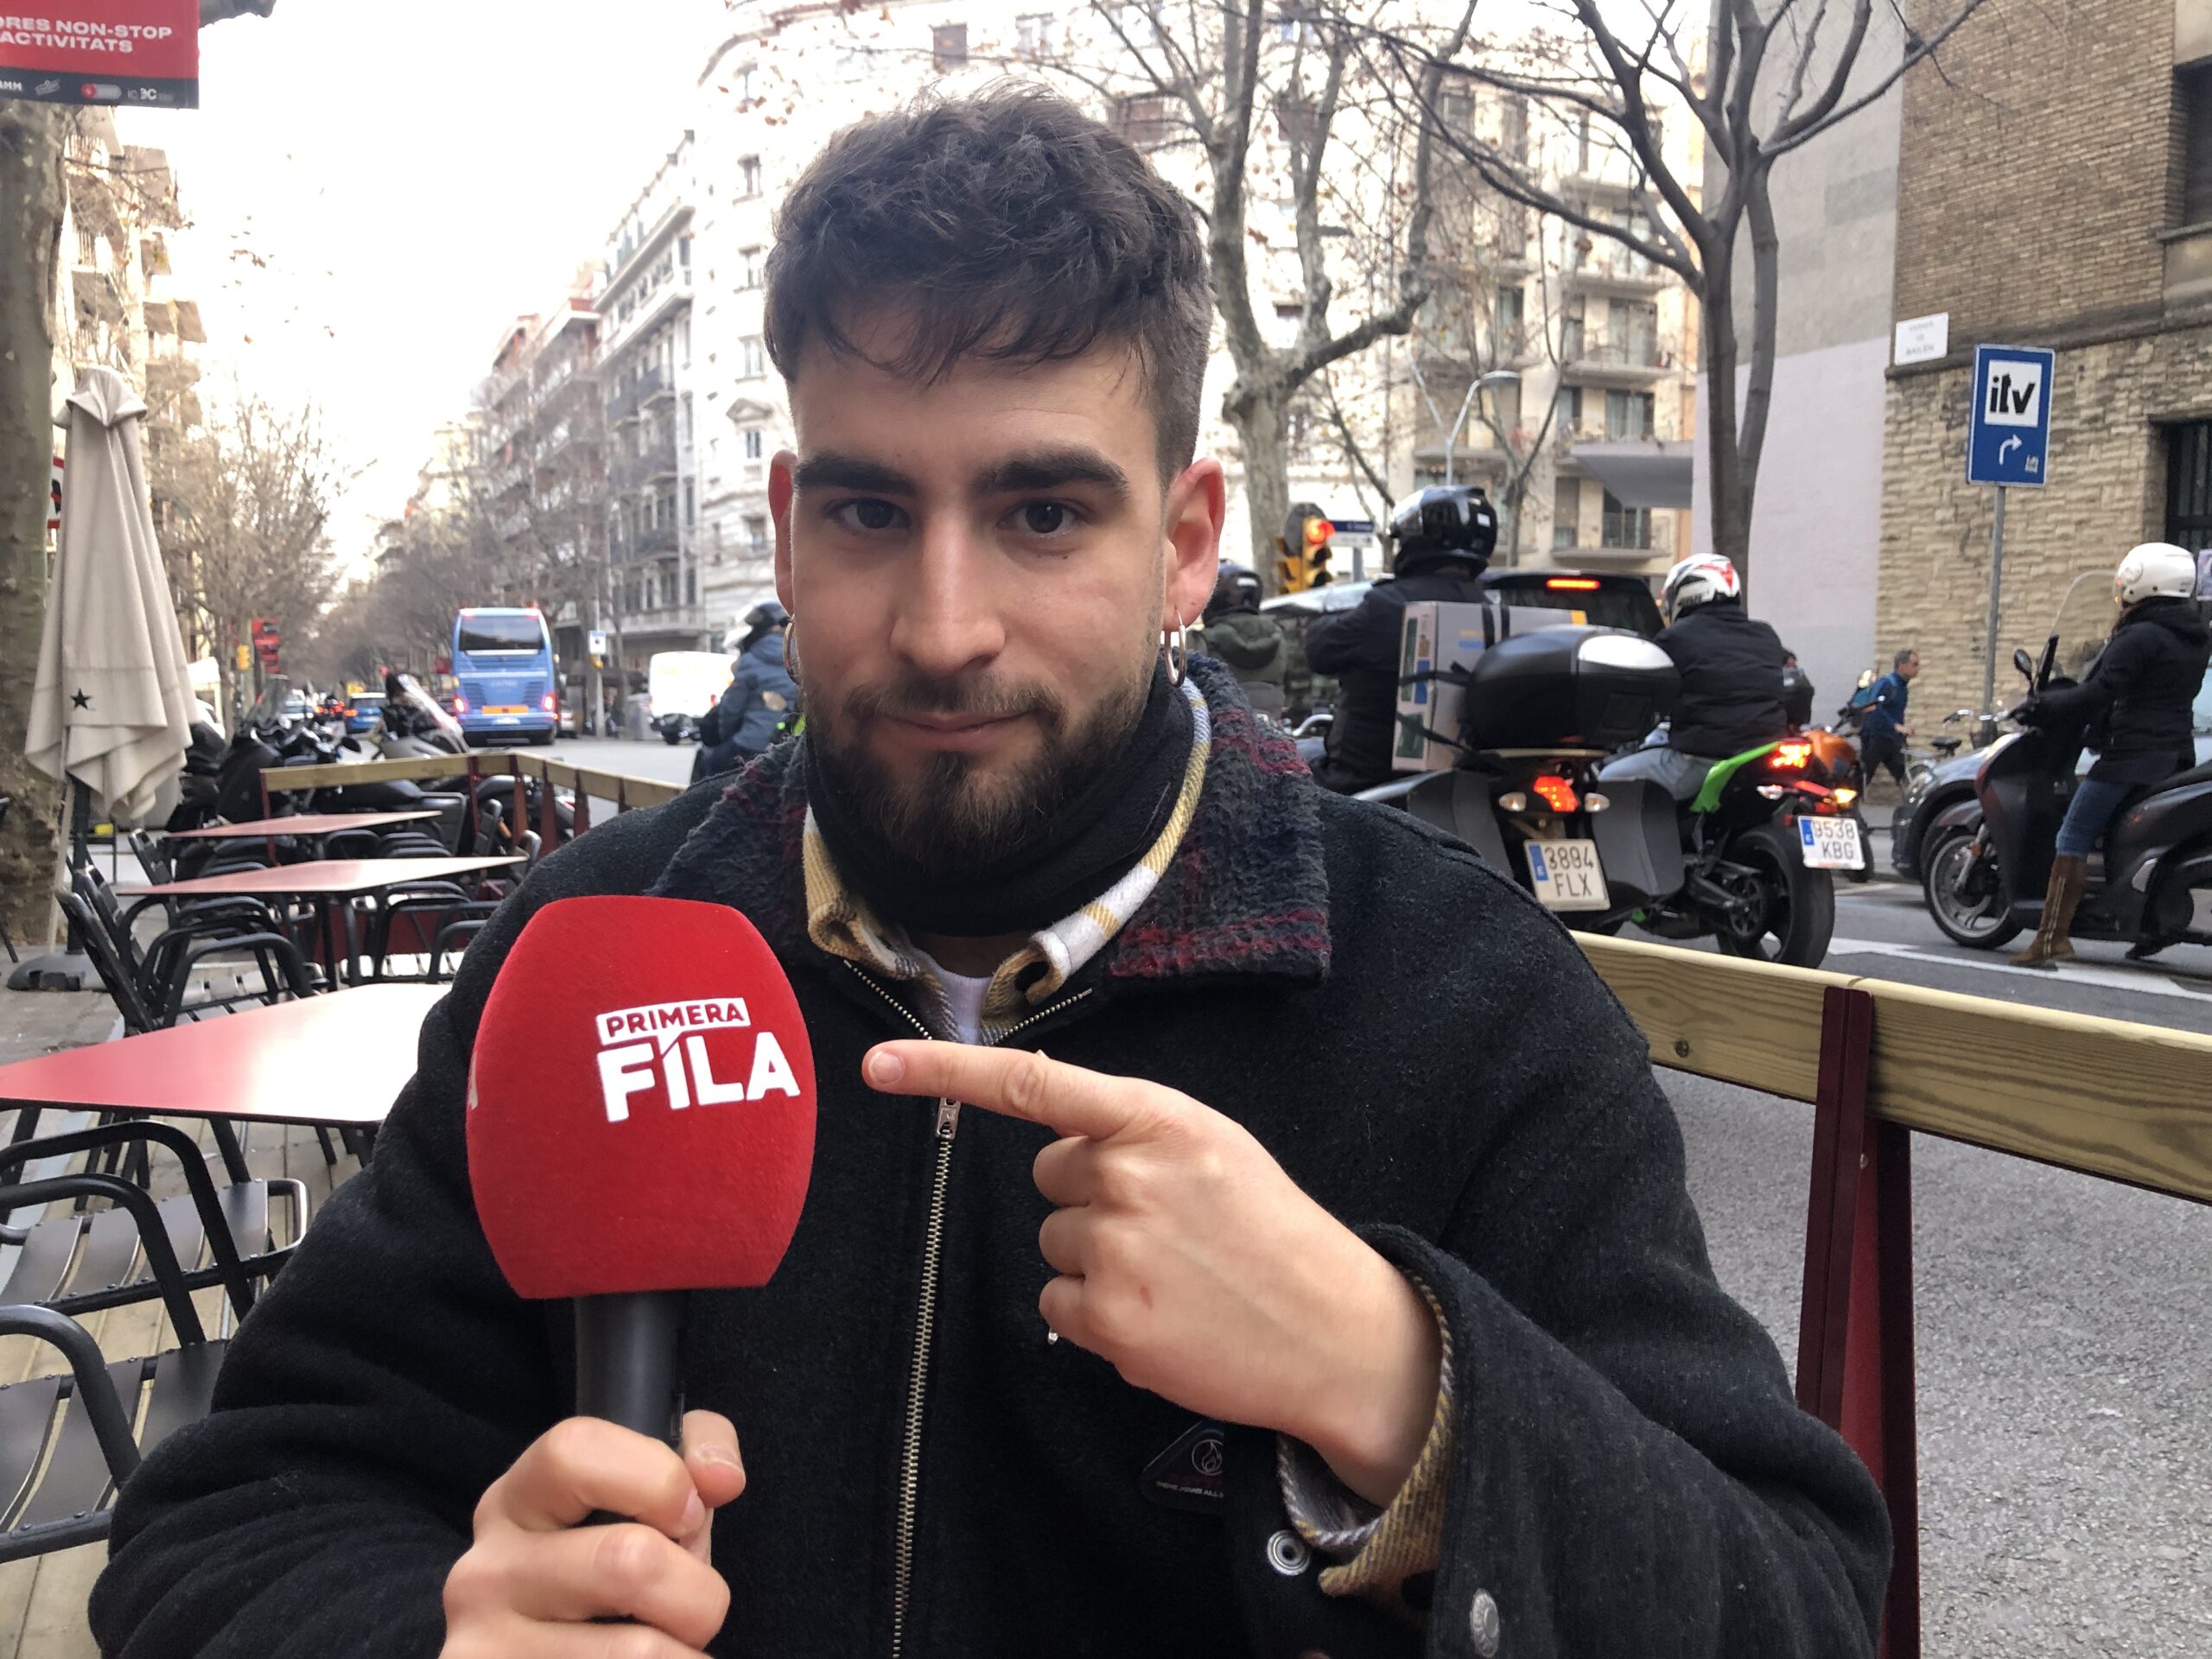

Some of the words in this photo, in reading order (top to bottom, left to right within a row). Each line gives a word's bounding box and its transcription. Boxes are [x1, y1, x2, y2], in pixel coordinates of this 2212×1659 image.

[0, 16, 51, 31] RES
[55, 20, 173, 40] NON-STOP
[0, 30, 133, 54] ACTIVITATS
[1821, 841, 1854, 860] KBG
[1554, 872, 1592, 897] FLX
[606, 1001, 746, 1038] PRIMERA
[596, 1032, 801, 1123] FILA
